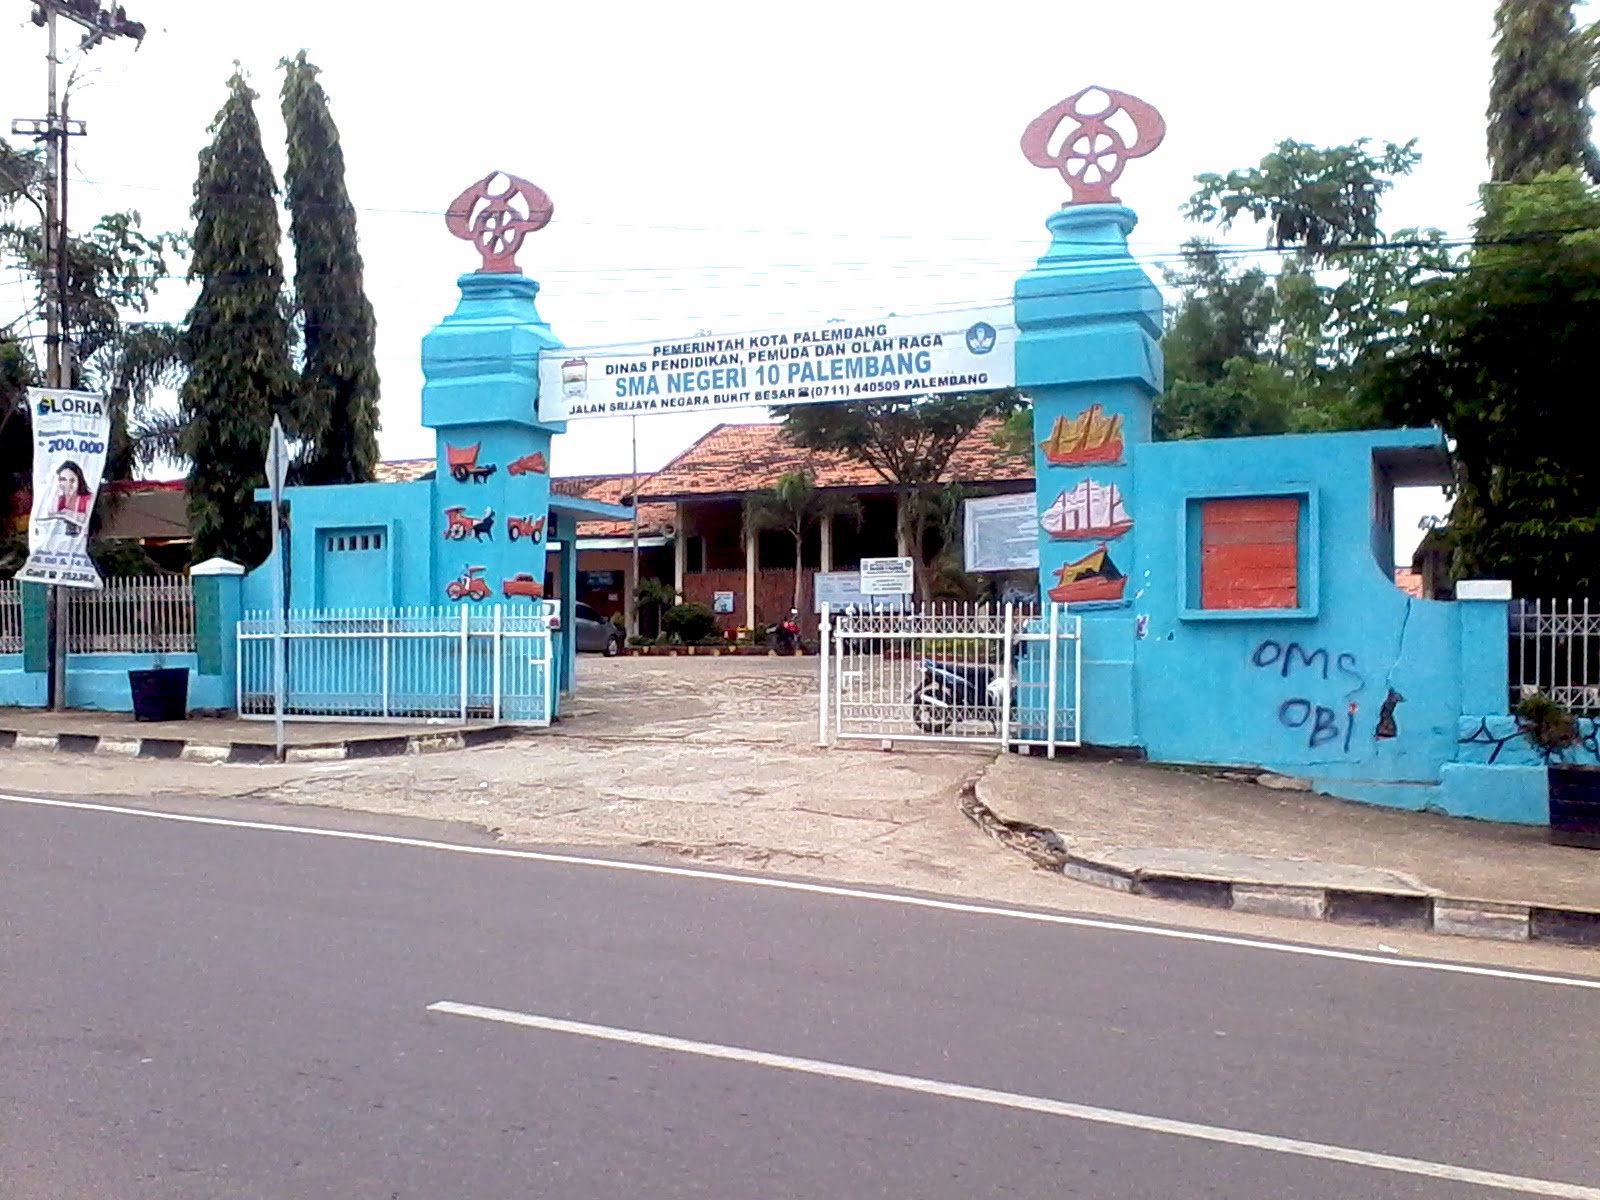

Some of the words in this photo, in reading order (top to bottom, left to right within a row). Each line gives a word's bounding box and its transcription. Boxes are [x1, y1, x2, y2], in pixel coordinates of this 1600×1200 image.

[605, 361, 647, 375] DINAS
[651, 353, 744, 371] PENDIDIKAN,
[748, 346, 809, 363] PEMUDA
[815, 343, 846, 357] DAN
[851, 338, 893, 354] OLAH
[899, 335, 943, 350] RAGA
[653, 338, 744, 357] PEMERINTAH
[749, 335, 788, 348] KOTA
[793, 324, 887, 344] PALEMBANG
[569, 402, 606, 415] JALAN
[609, 400, 657, 412] SRIJAYA
[660, 396, 710, 408] NEGARA
[714, 392, 750, 404] BUKIT
[755, 389, 795, 401] BESAR
[811, 384, 850, 399] (0711)
[854, 380, 900, 393] 440509
[904, 373, 988, 390] PALEMBANG
[615, 374, 660, 397] SMA
[667, 367, 747, 394] NEGERI
[755, 364, 780, 386] 10
[788, 351, 931, 384] PALEMBANG
[39, 398, 102, 415] GLORIA
